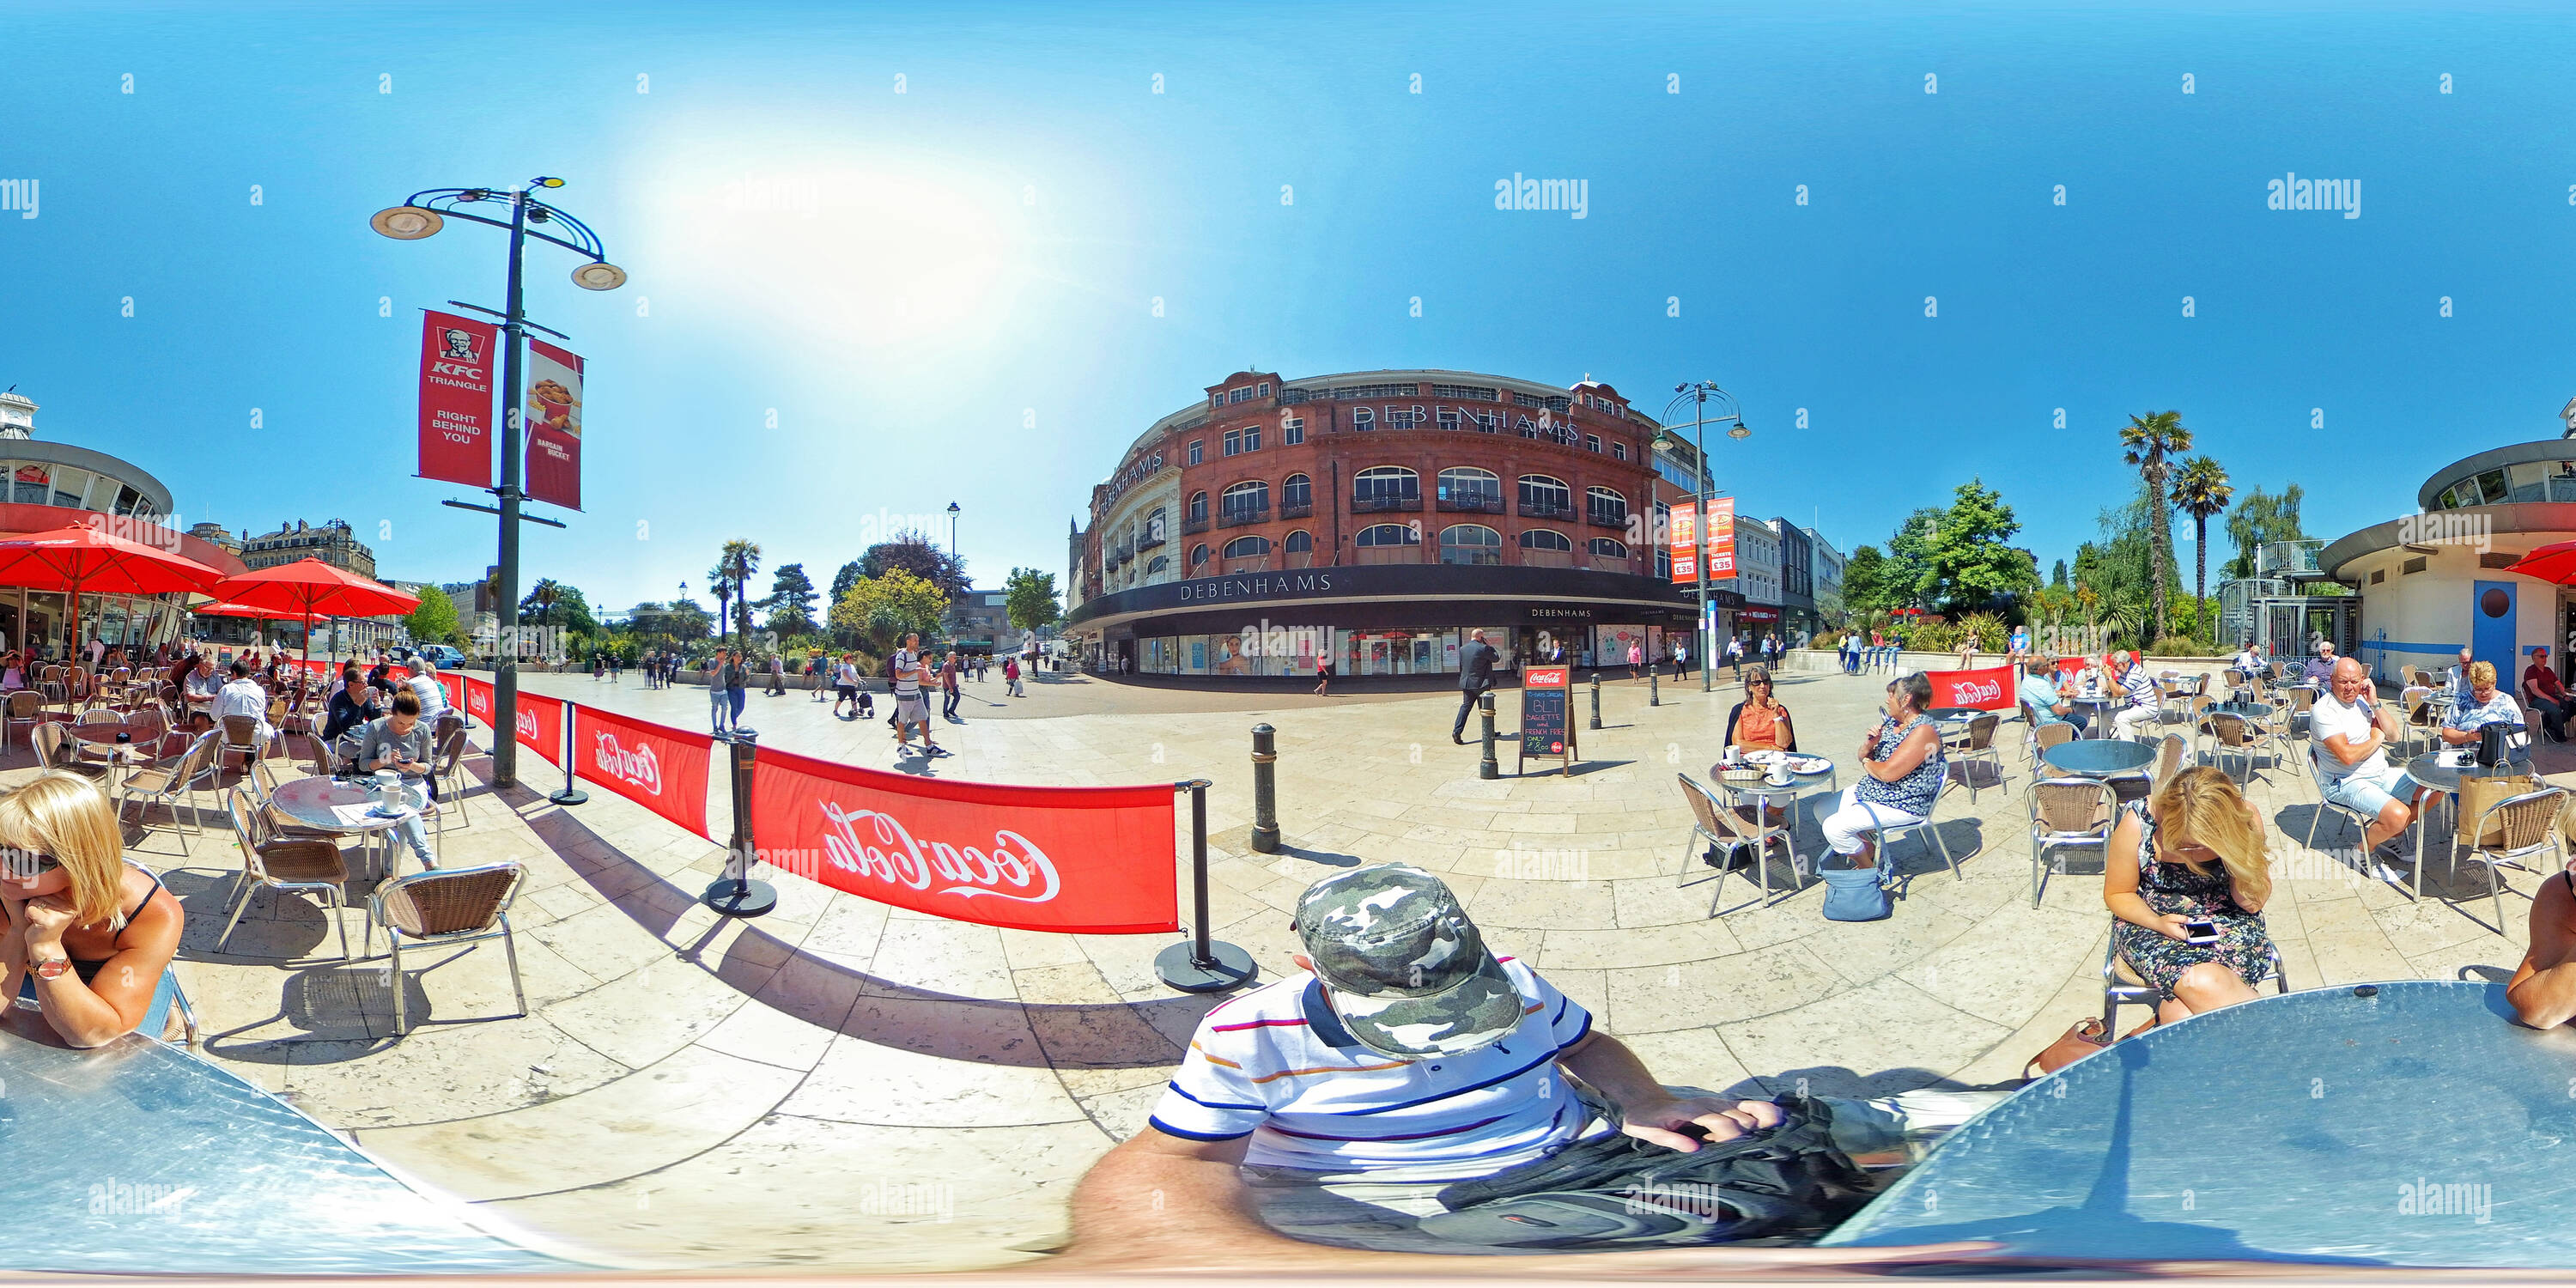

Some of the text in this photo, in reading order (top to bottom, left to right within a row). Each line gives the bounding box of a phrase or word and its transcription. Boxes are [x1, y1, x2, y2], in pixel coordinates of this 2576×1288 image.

[430, 361, 483, 380] KFC
[428, 375, 487, 392] TRIANGLE
[437, 410, 477, 424] RIGHT
[1353, 404, 1578, 441] DEBENHAMS
[432, 419, 481, 435] BEHIND
[443, 431, 471, 444] YOU
[537, 438, 562, 452] BARGAIN
[547, 447, 570, 461] BUCKET
[1100, 449, 1163, 517] DEBENHAMS
[1676, 565, 1692, 574] £35
[1713, 561, 1731, 569] £35
[1181, 574, 1331, 600] DEBENHAMS
[1532, 609, 1591, 617] DEBENHAMS
[1533, 699, 1561, 713] BLT
